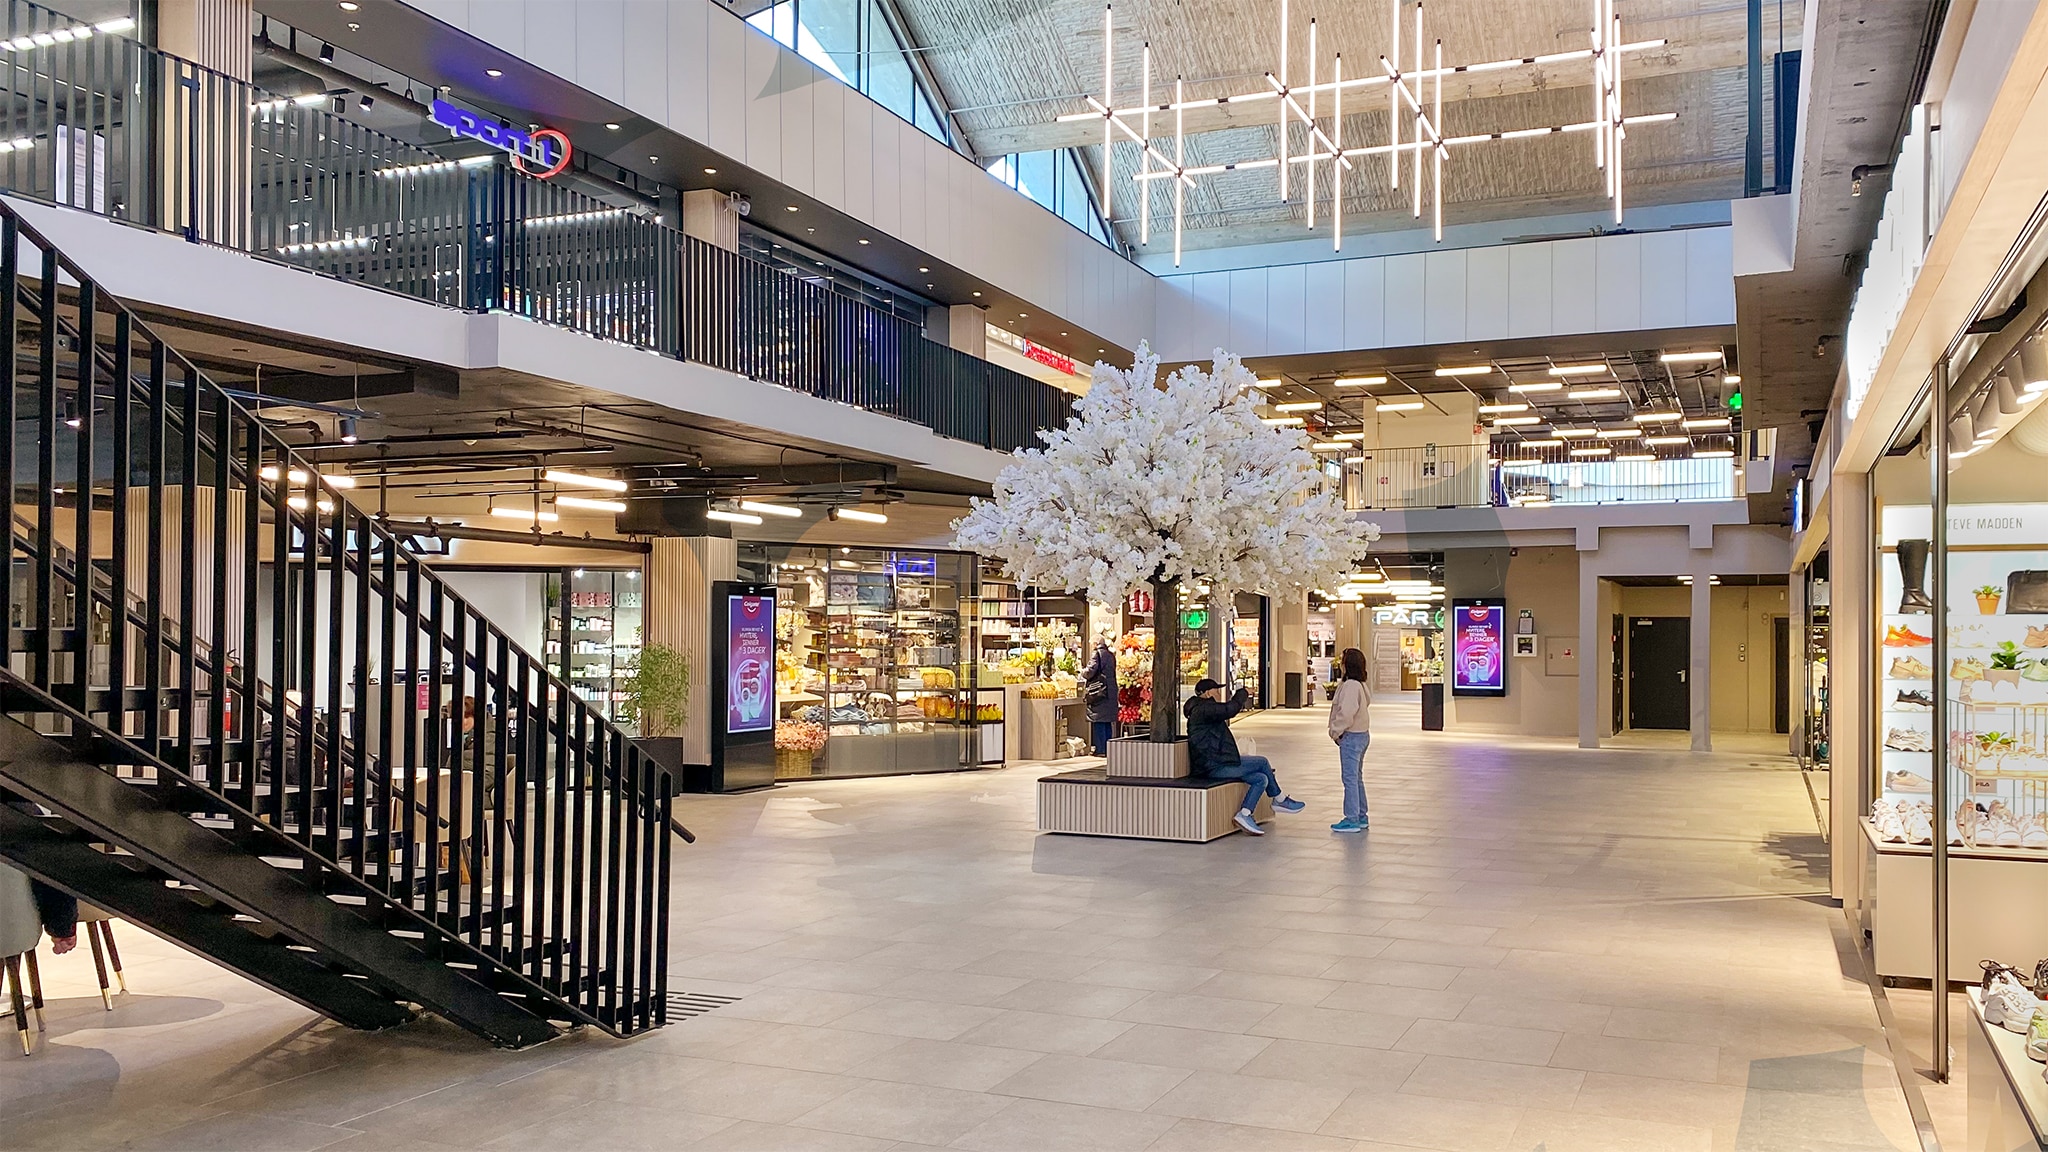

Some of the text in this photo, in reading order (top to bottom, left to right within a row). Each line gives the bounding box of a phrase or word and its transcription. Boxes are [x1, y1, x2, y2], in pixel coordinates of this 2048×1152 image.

[1947, 517, 2023, 530] TEVE MADDEN
[1371, 610, 1429, 626] PAR
